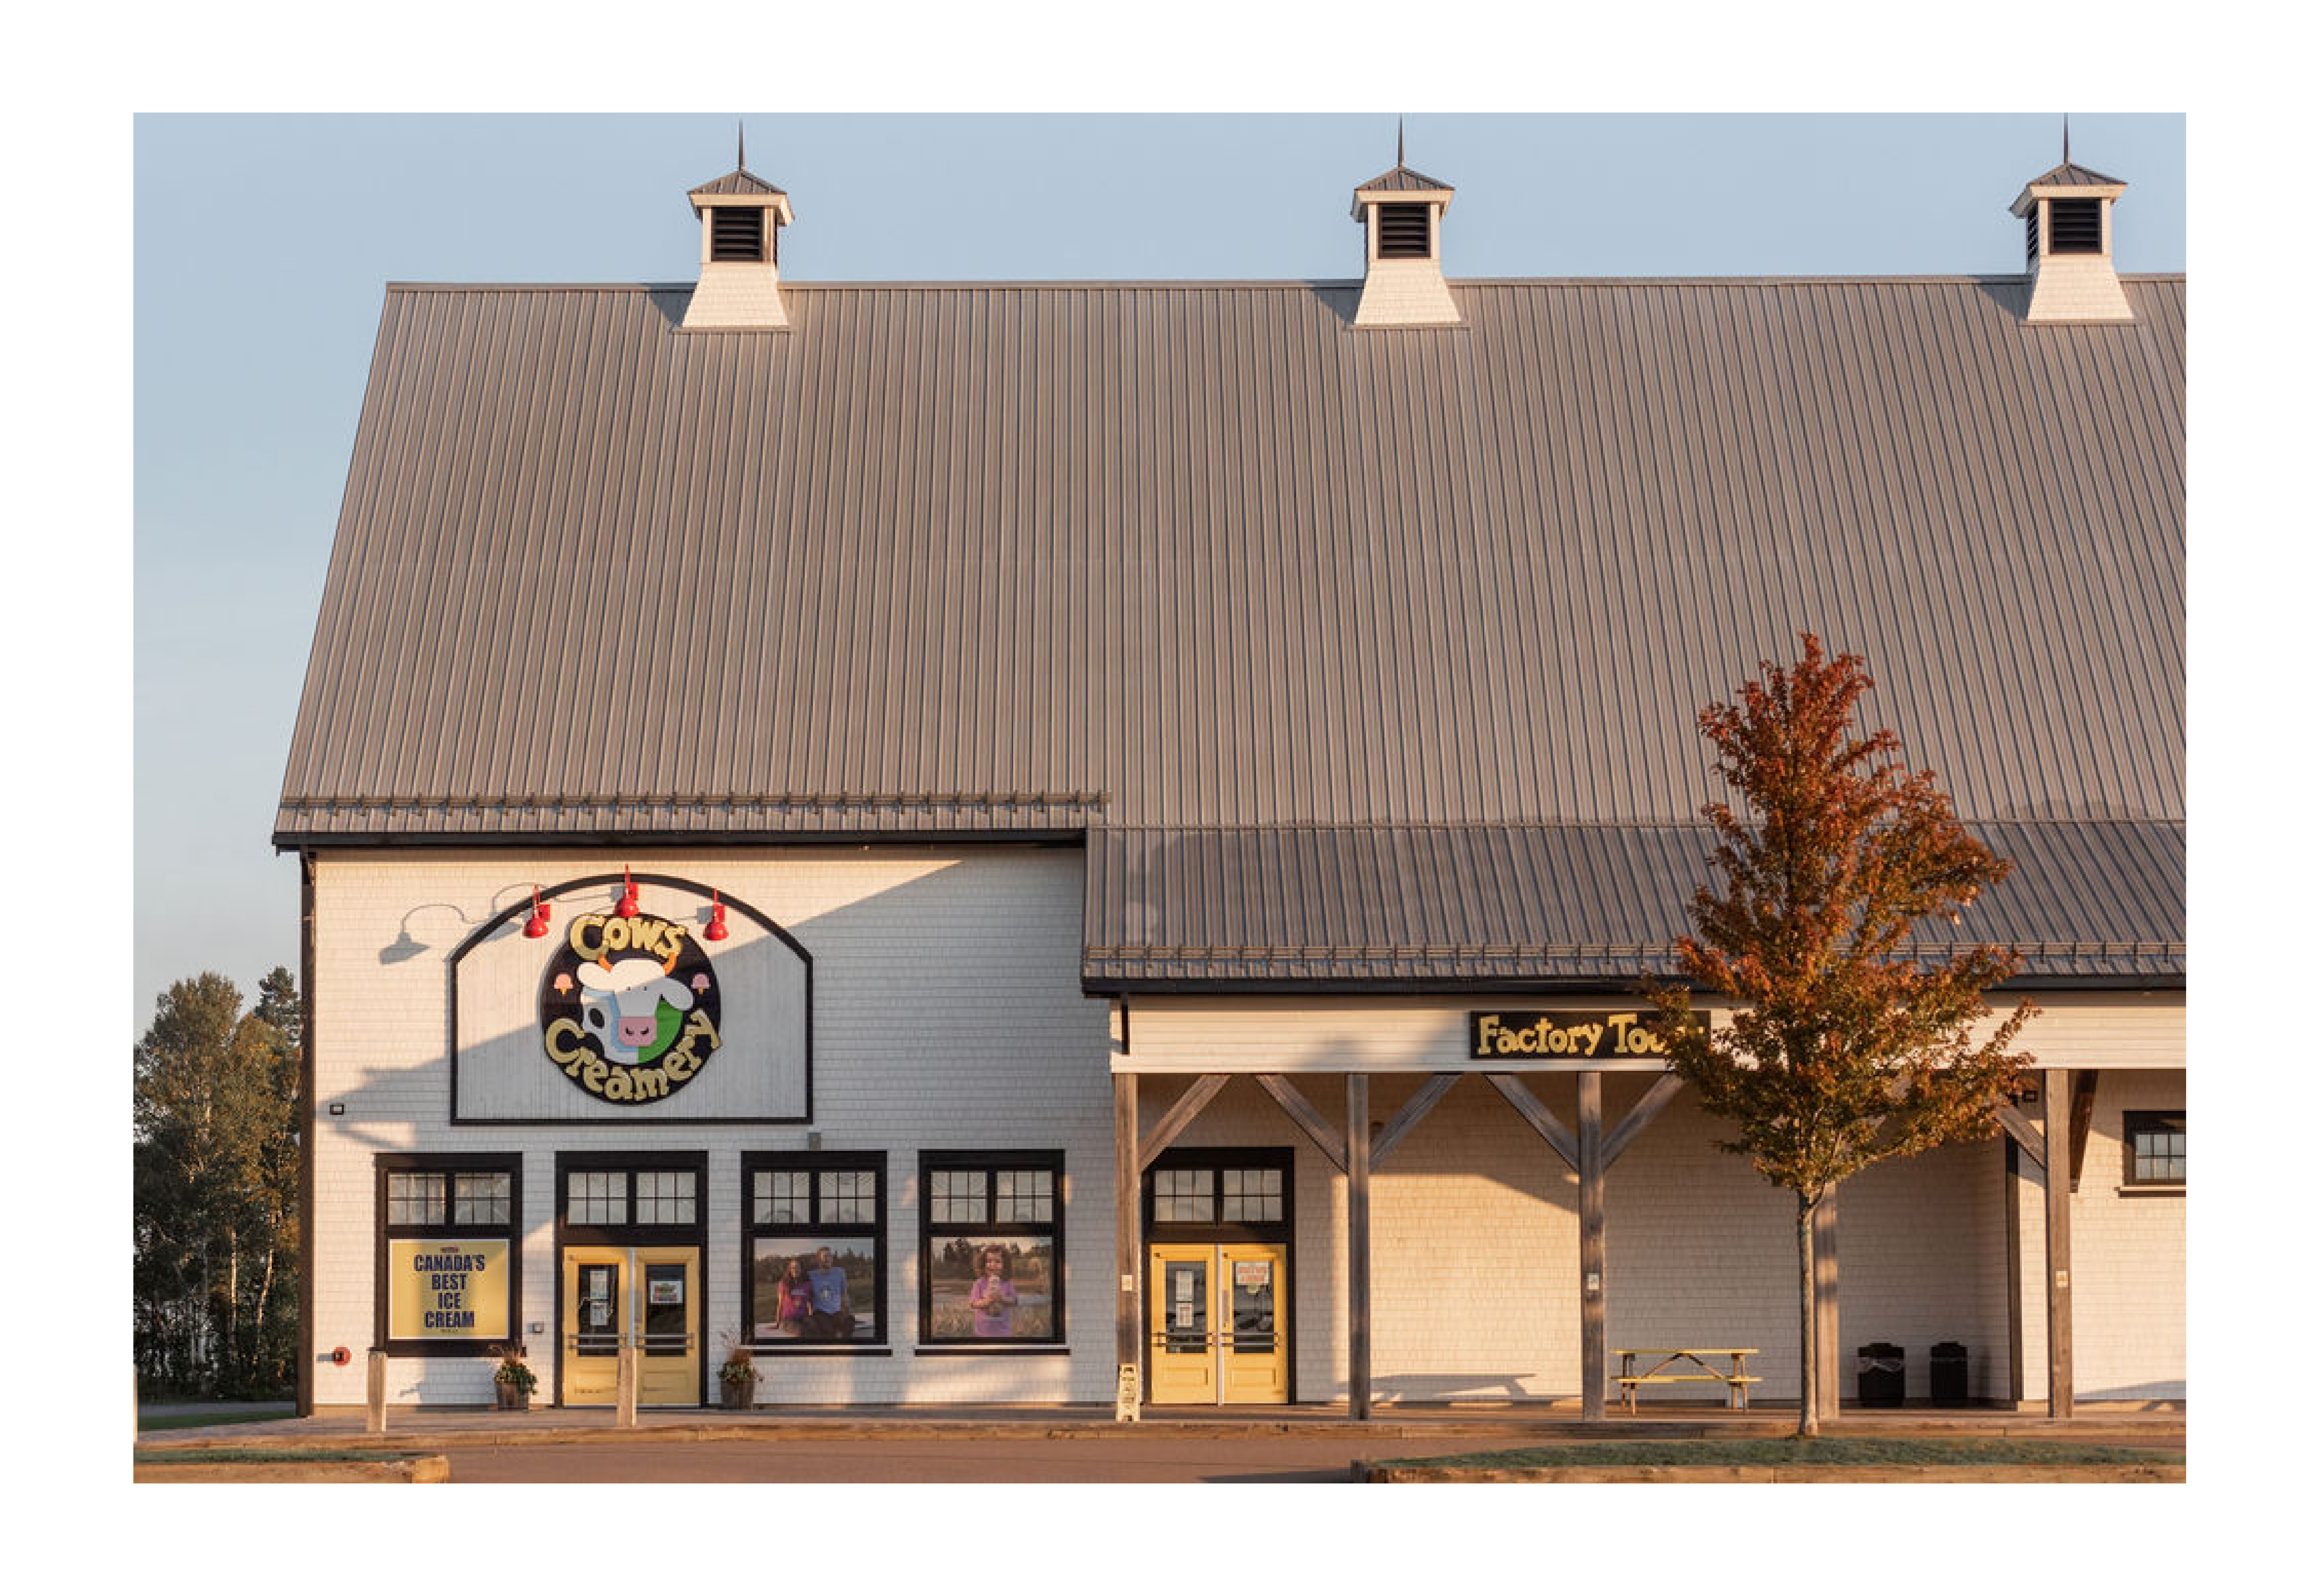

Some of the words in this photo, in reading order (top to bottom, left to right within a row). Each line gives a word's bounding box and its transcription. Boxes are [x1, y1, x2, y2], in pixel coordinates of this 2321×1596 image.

[1477, 1014, 1603, 1057] Factory
[1609, 1014, 1705, 1054] Tou
[545, 1008, 723, 1101] Creamery
[413, 1255, 485, 1272] CANADA'S
[432, 1273, 467, 1290] BEST
[438, 1292, 461, 1309] ICE
[424, 1311, 475, 1328] CREAM
